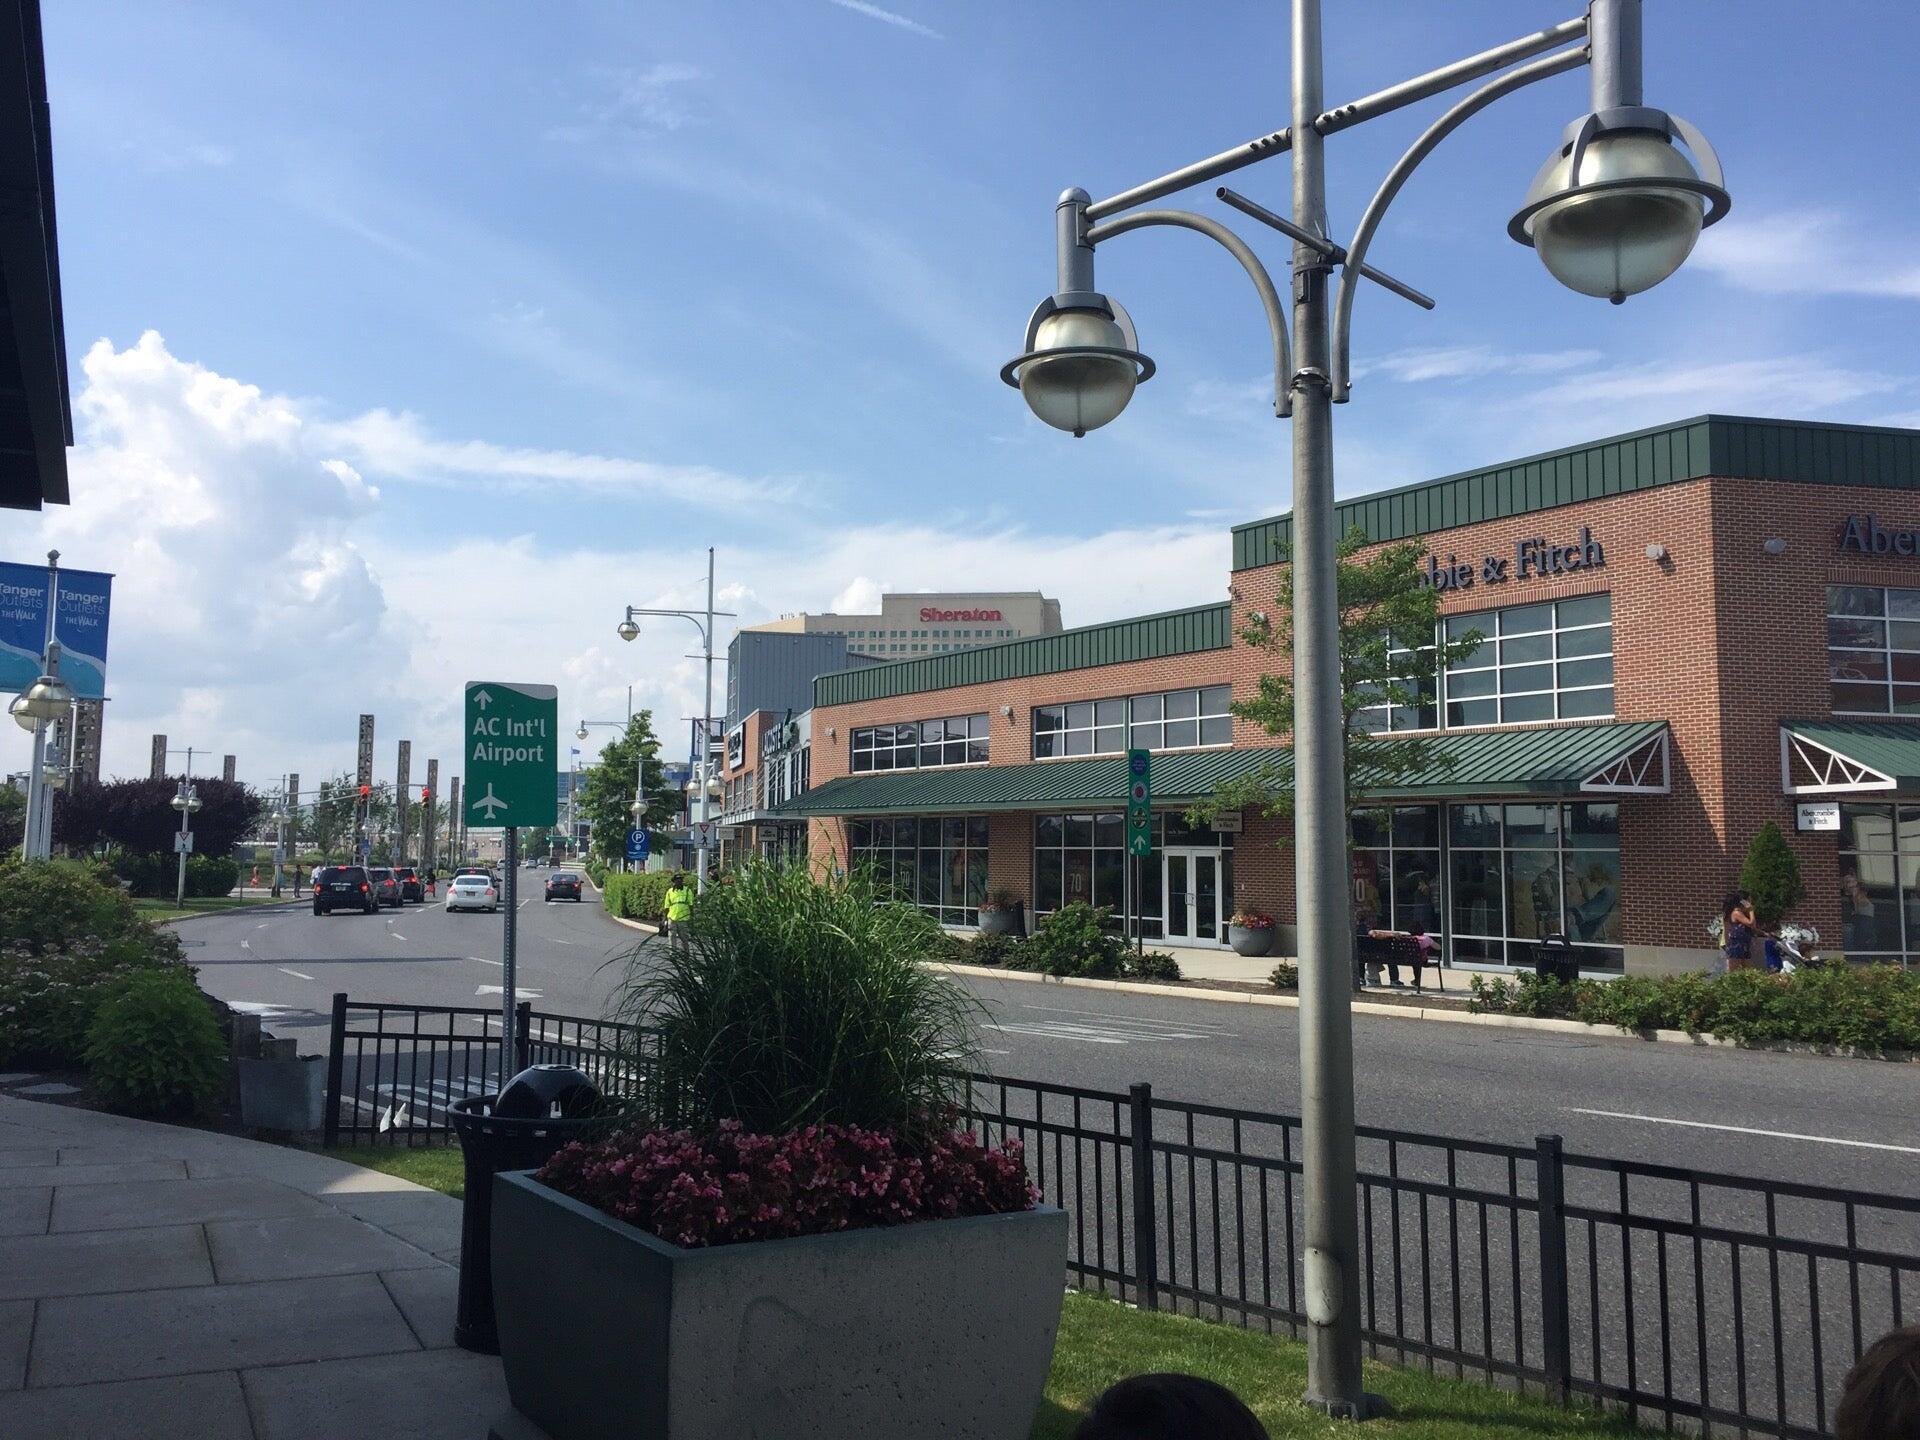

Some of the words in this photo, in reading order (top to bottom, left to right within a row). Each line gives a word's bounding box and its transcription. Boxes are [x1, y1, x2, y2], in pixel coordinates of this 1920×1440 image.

[1481, 556, 1507, 582] &
[1514, 526, 1605, 578] Fitch
[58, 599, 105, 615] Outlets
[59, 589, 106, 605] Tanger
[919, 607, 1002, 622] Sheraton
[473, 717, 500, 736] AC
[507, 718, 546, 738] Int'l
[472, 742, 544, 766] Airport
[1070, 873, 1082, 893] 70
